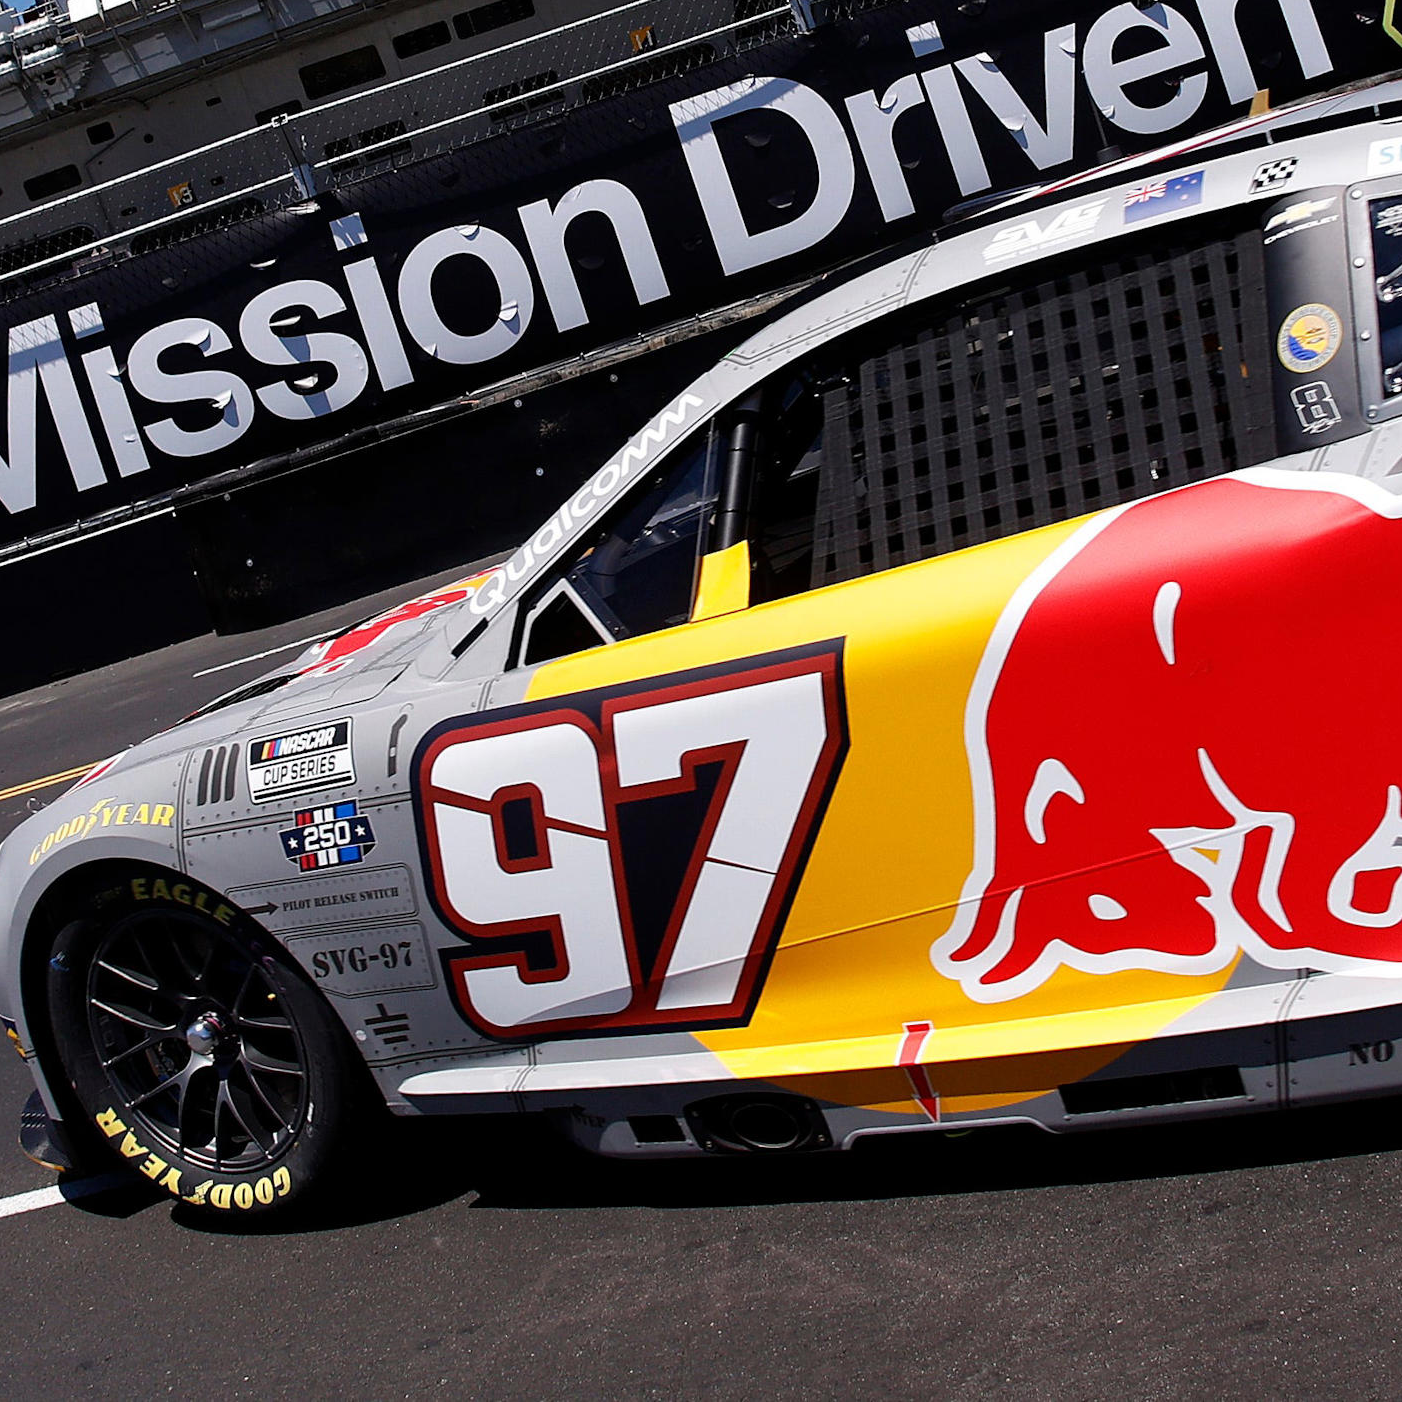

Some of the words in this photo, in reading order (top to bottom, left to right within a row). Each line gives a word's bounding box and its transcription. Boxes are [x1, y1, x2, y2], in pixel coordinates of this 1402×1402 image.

[1263, 214, 1340, 245] CHEVROLET
[469, 392, 705, 616] Qualcomm
[278, 726, 337, 756] NASCAR
[263, 767, 288, 786] CUP
[290, 755, 337, 780] SERIES
[303, 820, 352, 852] 250
[418, 650, 846, 1034] 97
[131, 878, 237, 927] EAGLE
[282, 899, 312, 913] PILOT
[314, 892, 357, 907] RELEASE
[360, 887, 399, 902] SWITCH
[312, 942, 412, 978] SVG-97
[1349, 1039, 1395, 1066] NO
